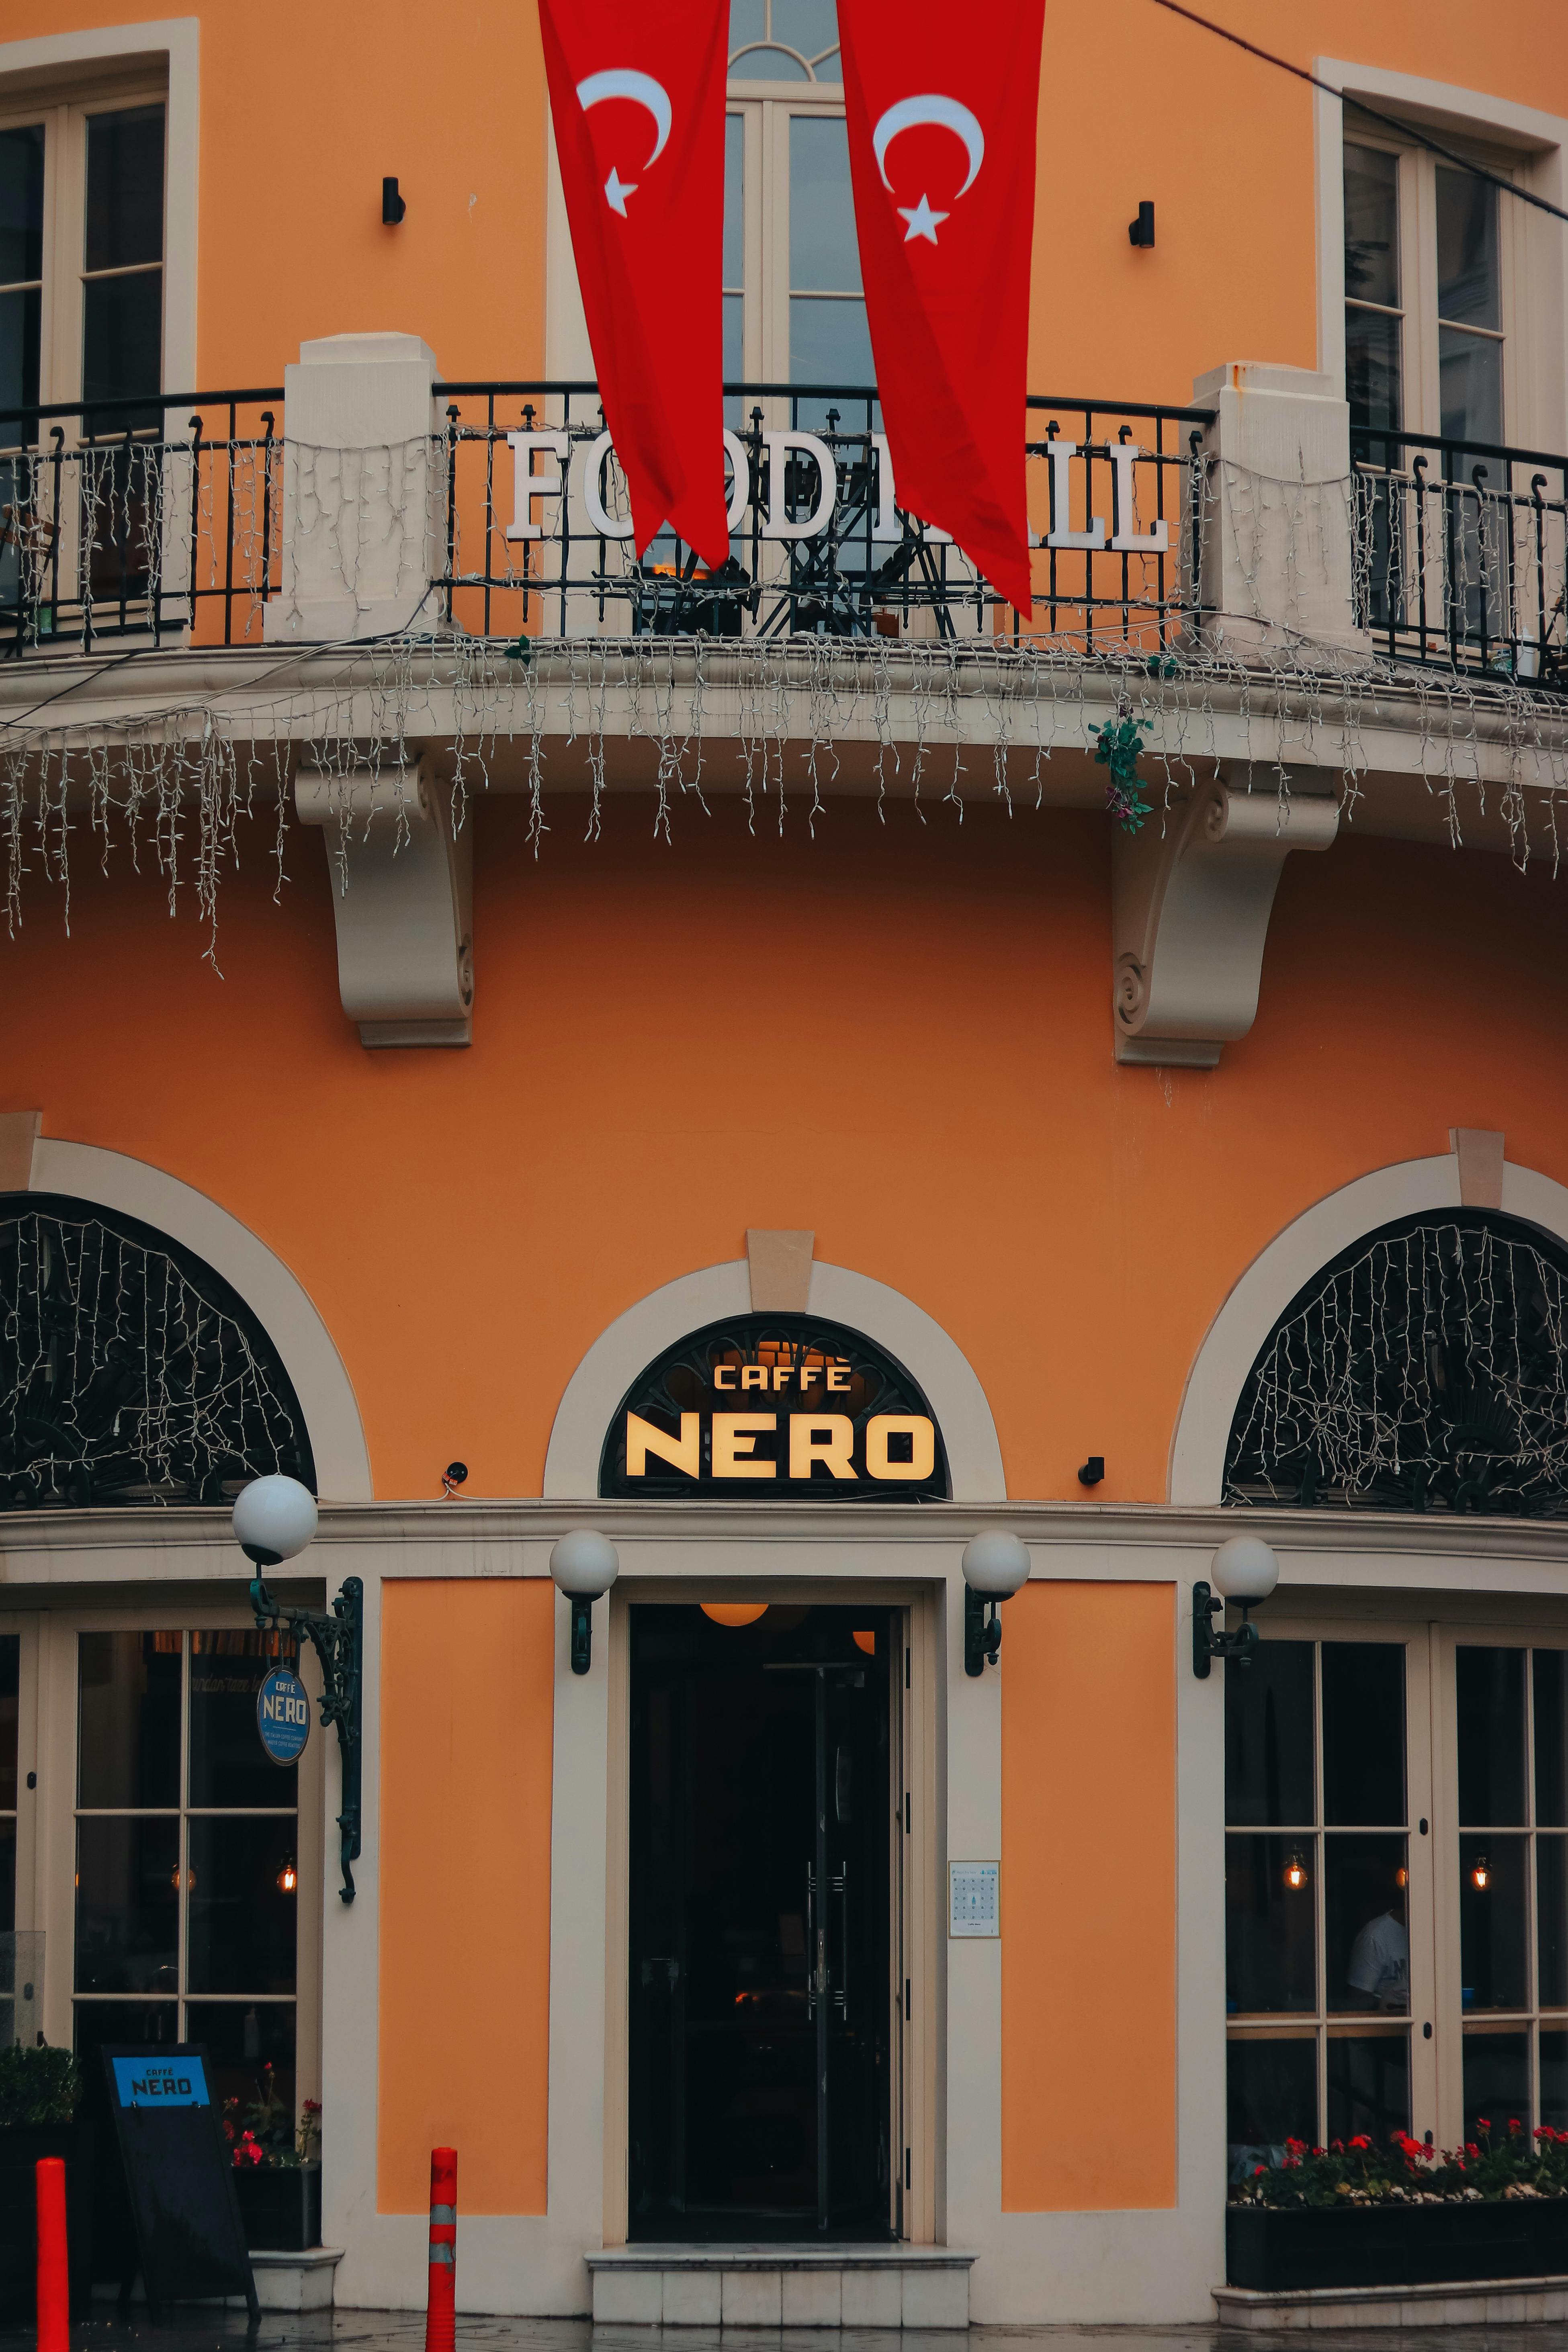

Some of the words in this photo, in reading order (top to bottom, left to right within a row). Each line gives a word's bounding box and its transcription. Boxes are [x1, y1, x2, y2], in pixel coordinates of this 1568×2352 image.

[714, 1357, 852, 1392] CAFFÈ
[626, 1410, 935, 1480] NERO
[276, 1681, 296, 1694] CAFFÈ
[263, 1695, 306, 1725] NERO
[146, 2067, 174, 2076] CAFFÈ
[132, 2078, 192, 2096] NERO
